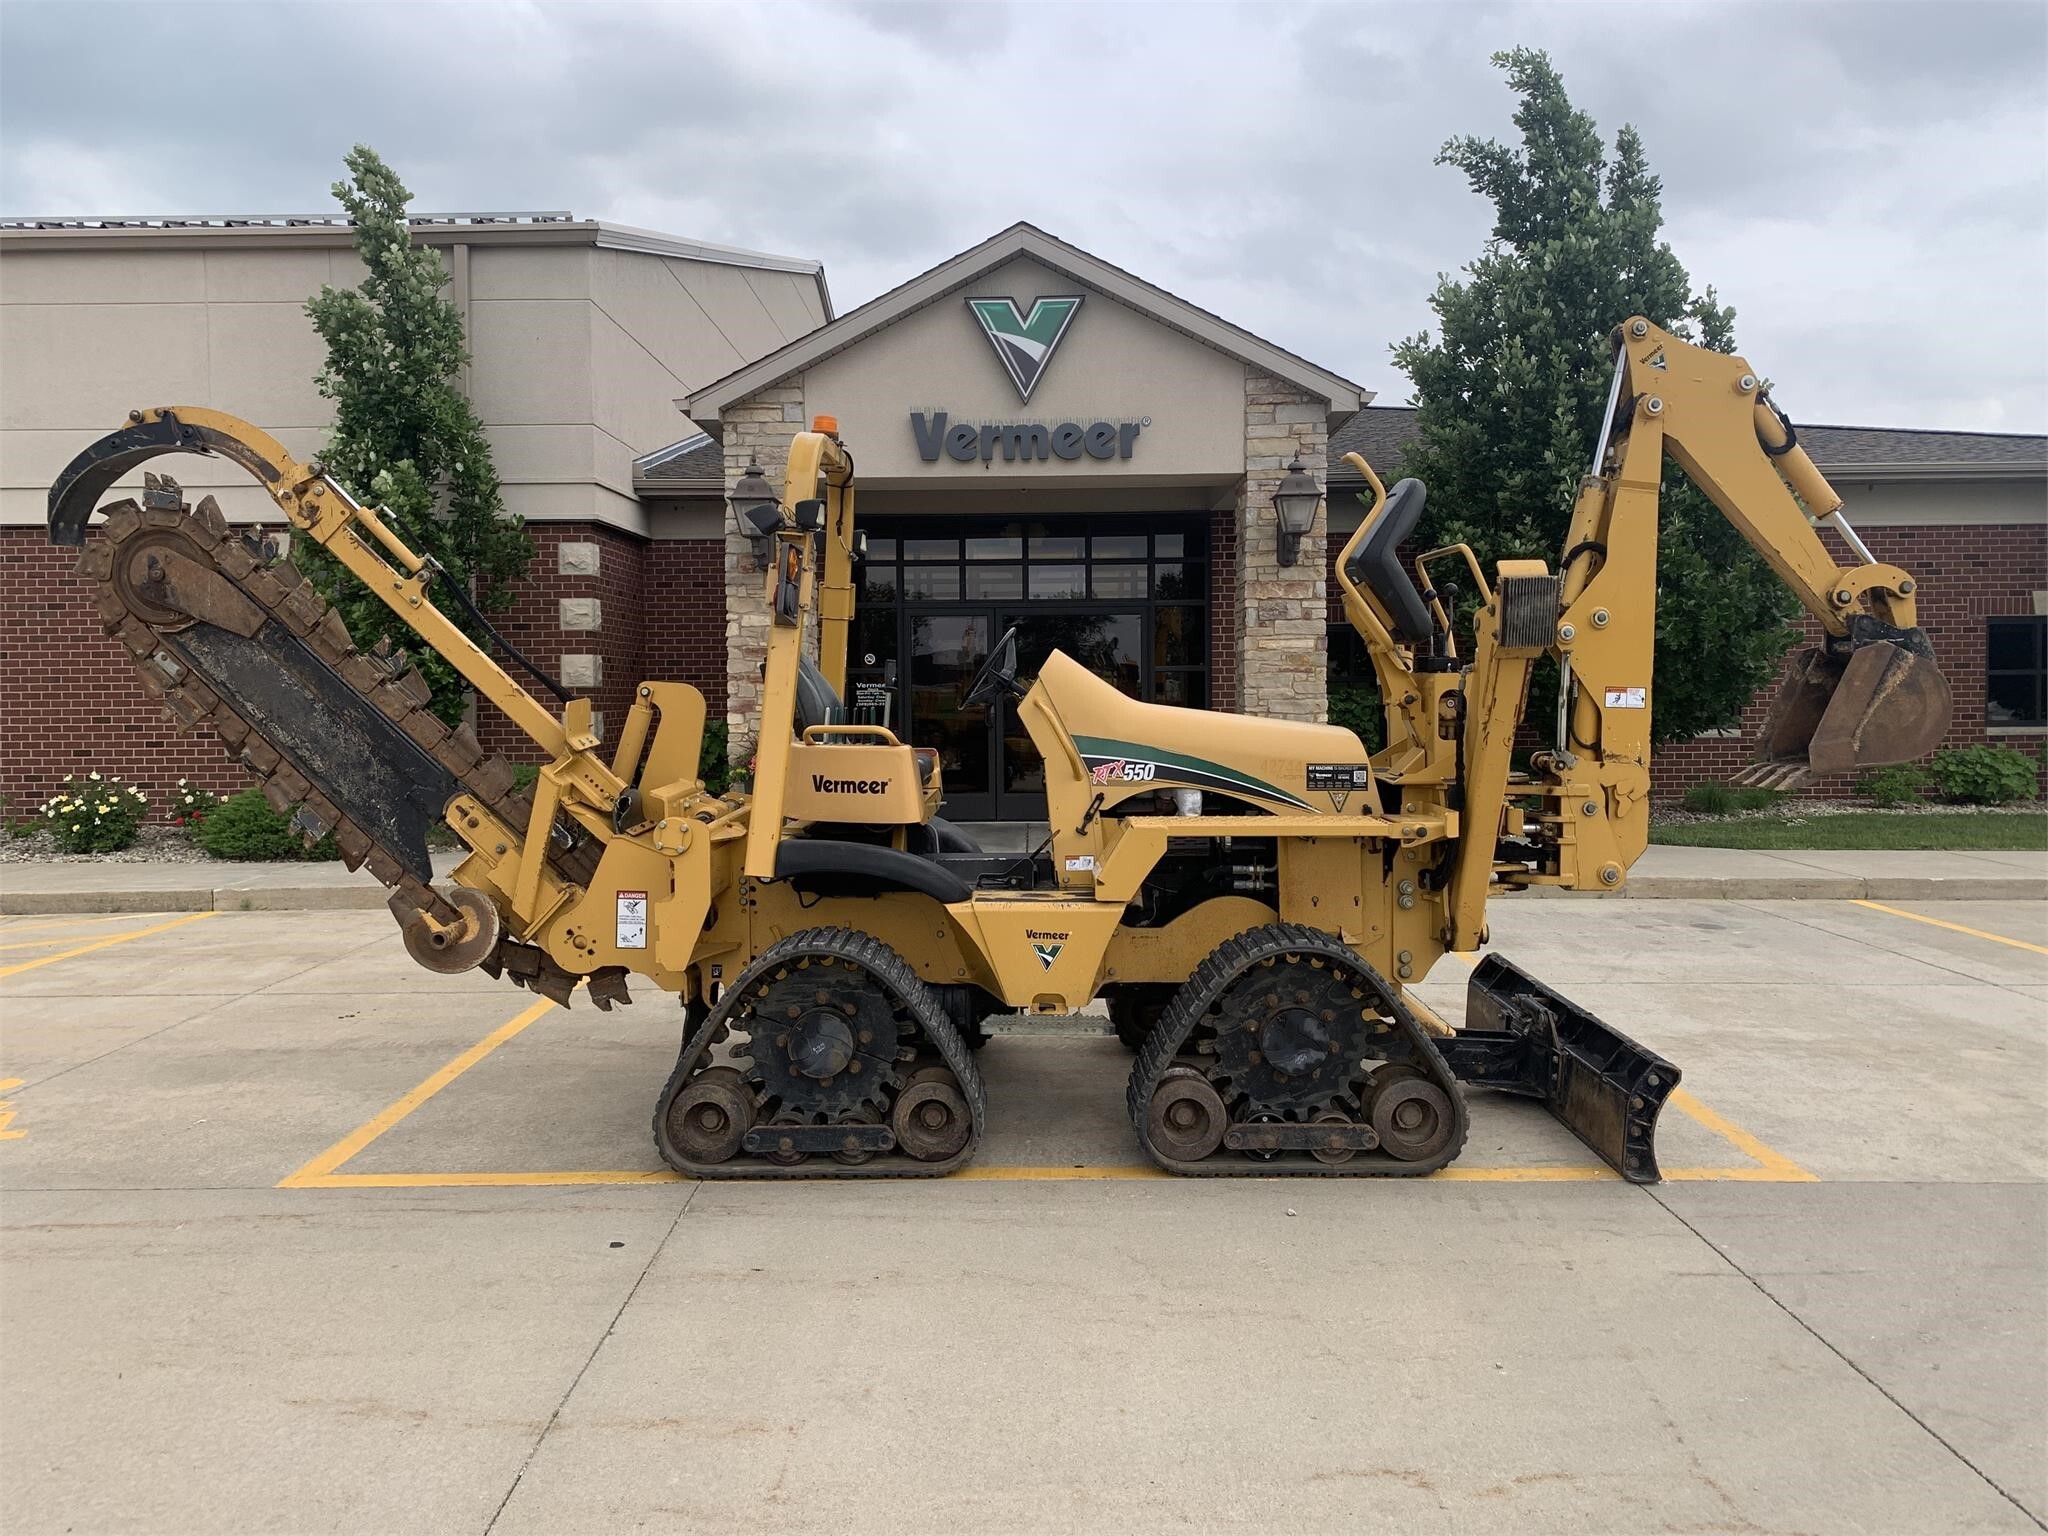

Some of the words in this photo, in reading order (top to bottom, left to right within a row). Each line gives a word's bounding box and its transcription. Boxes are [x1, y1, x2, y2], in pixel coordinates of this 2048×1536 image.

[1639, 343, 1664, 364] Vermeer
[909, 412, 1141, 462] Vermeer
[812, 774, 888, 794] Vermeer
[1026, 929, 1069, 940] Vermeer
